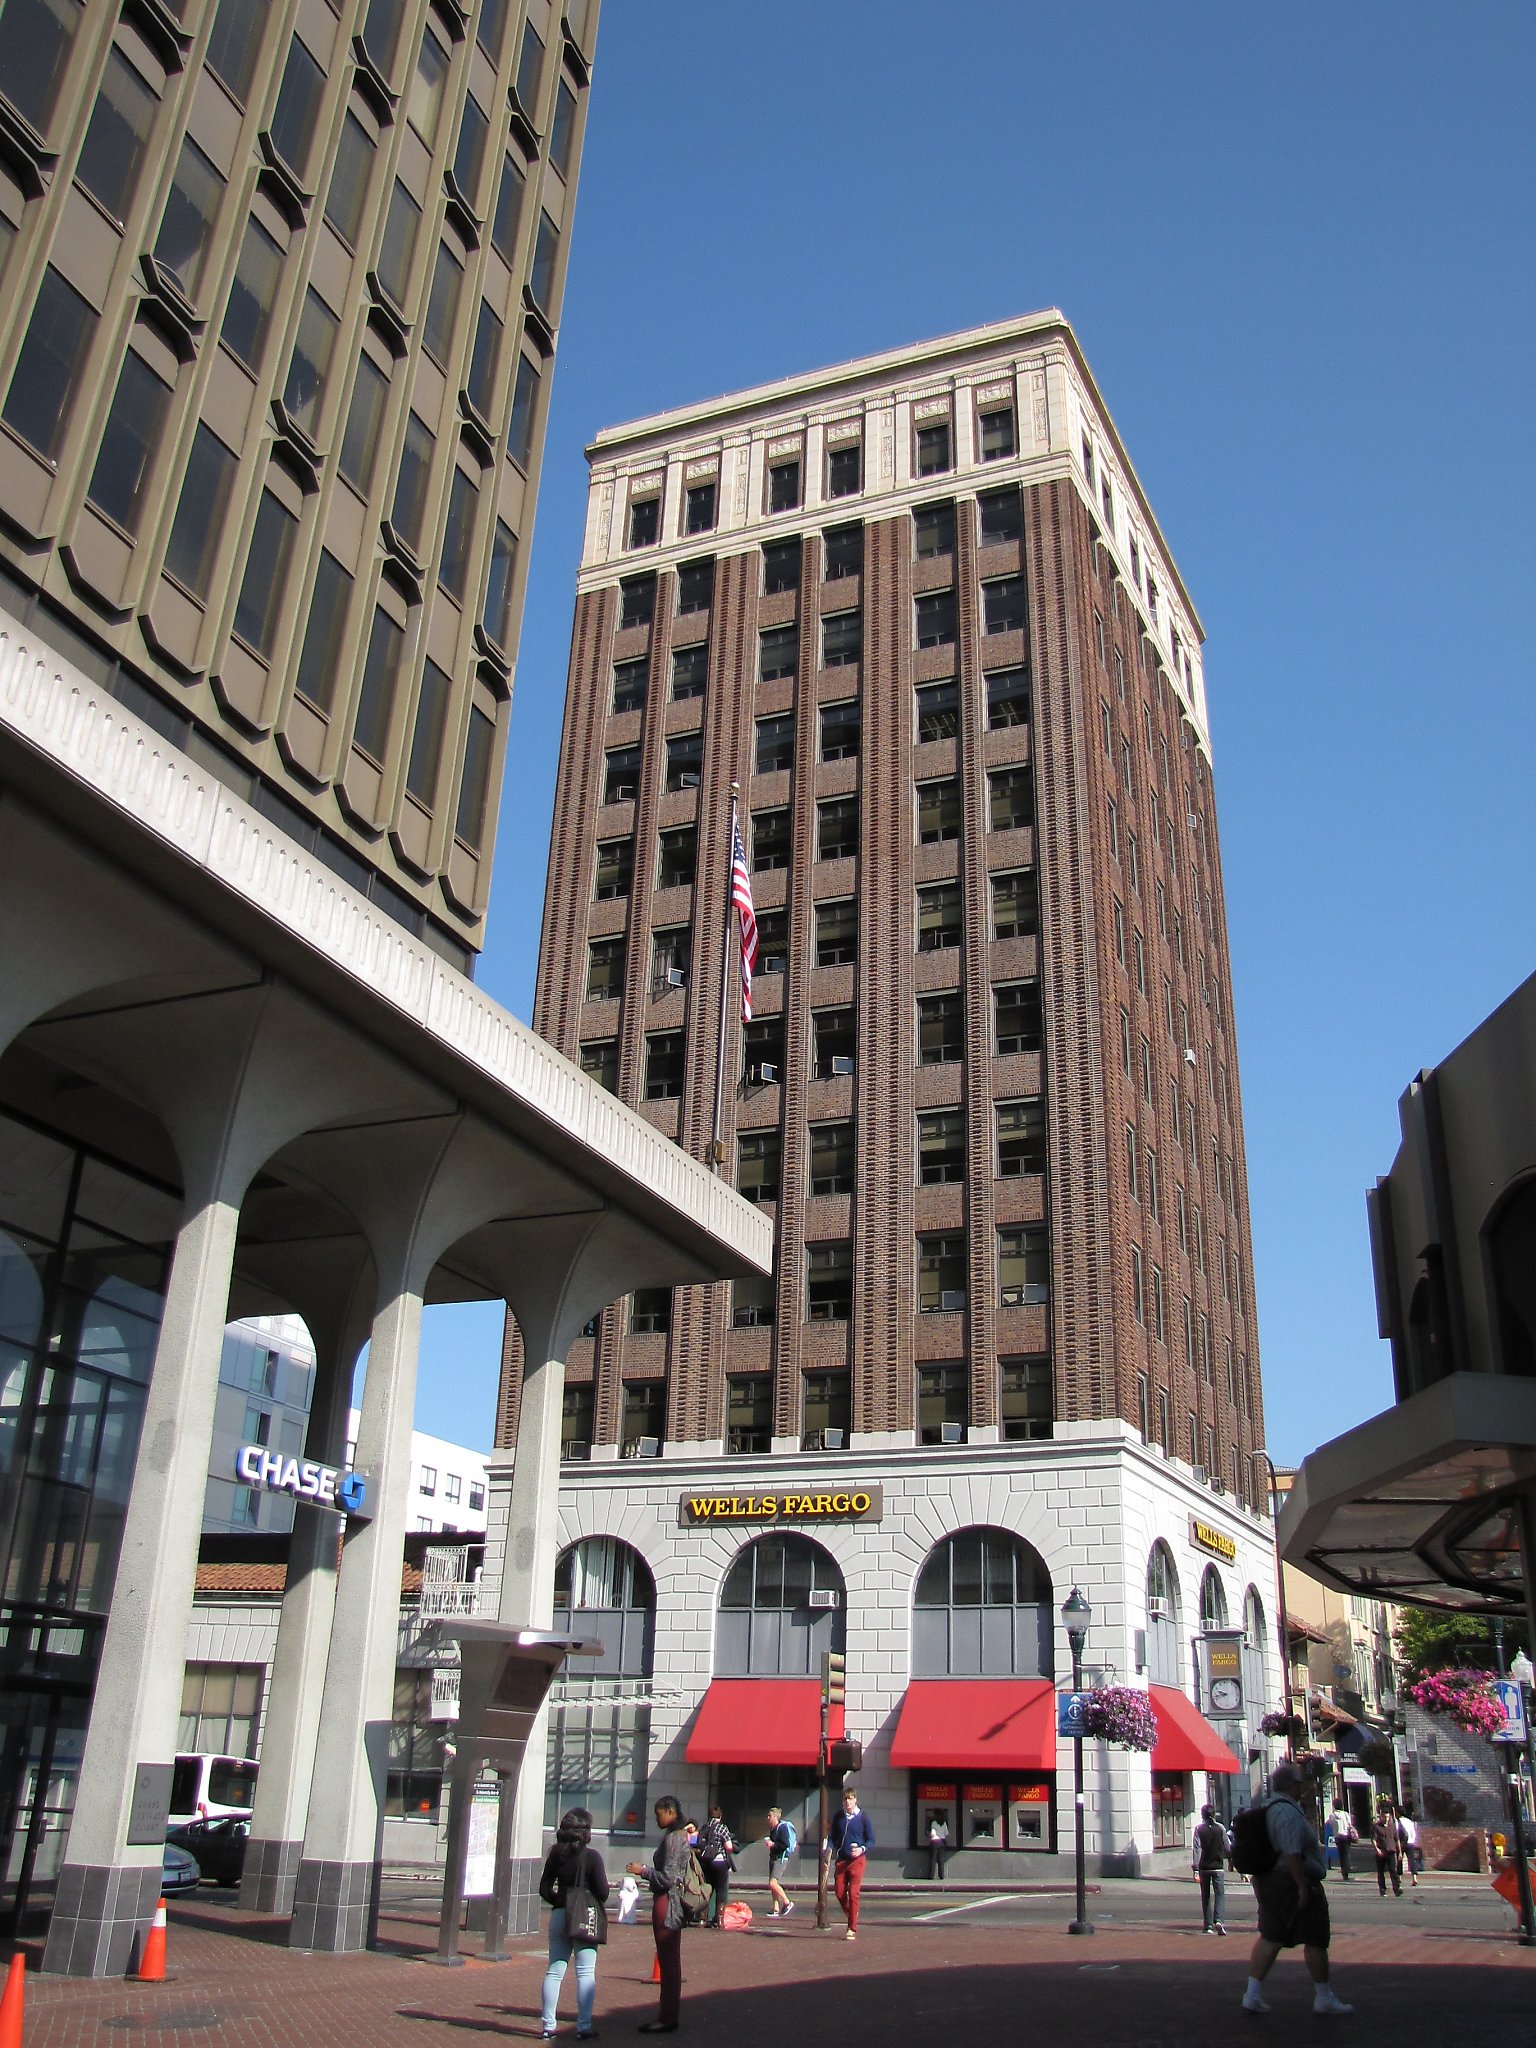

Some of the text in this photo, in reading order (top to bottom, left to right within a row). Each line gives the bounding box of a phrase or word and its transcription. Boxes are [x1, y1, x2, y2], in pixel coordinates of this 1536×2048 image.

[238, 1445, 338, 1501] CHASE
[690, 1492, 872, 1516] WELLS FARGO
[1195, 1521, 1236, 1558] WELLS FARGO
